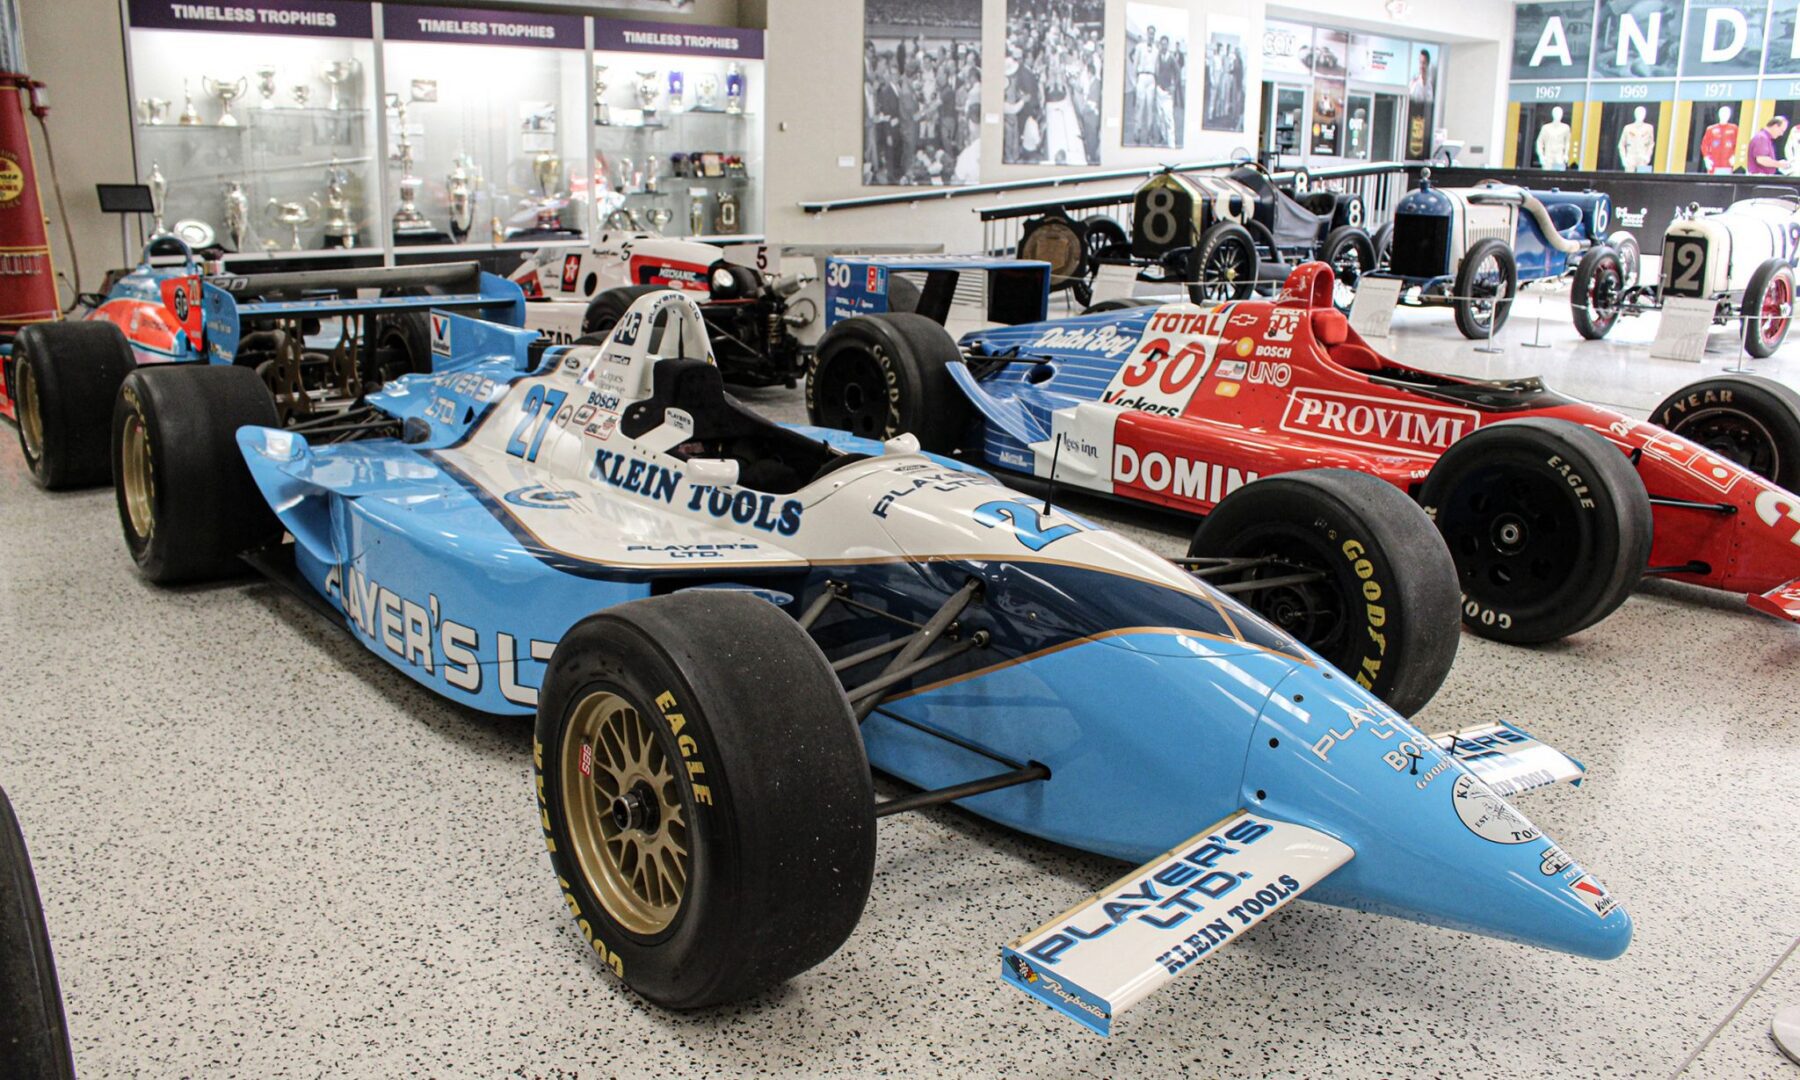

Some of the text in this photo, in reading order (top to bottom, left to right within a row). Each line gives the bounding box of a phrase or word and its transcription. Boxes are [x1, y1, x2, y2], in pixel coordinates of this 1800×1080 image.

[171, 4, 336, 27] TIMELESS TROPHIES
[418, 19, 555, 39] TIMELESS TROPHIES
[623, 31, 739, 50] TIMELESS TROPHIES
[1535, 86, 1561, 98] 1967
[1620, 85, 1647, 98] 1969
[1704, 83, 1732, 97] 1971
[1296, 171, 1308, 193] 8
[1143, 187, 1177, 244] 8
[1348, 199, 1361, 228] 8
[1593, 200, 1608, 232] 16
[757, 246, 768, 270] 5
[1664, 242, 1704, 291] 12
[658, 268, 697, 281] MECHANIC
[827, 262, 851, 288] 30
[1150, 312, 1222, 336] TOTAL
[1089, 325, 1138, 359] Boy
[1255, 345, 1292, 359] BOSCH
[1122, 338, 1206, 395] 30
[1247, 361, 1292, 388] UNO
[587, 391, 619, 412] BOSCH
[1103, 389, 1180, 419] Vickers
[505, 383, 568, 463] 27
[1294, 398, 1466, 449] PROVIMI
[589, 448, 683, 504] KLEIN
[1112, 443, 1260, 505] DOMIN
[1547, 455, 1595, 509] EAGLE
[687, 484, 804, 536] TOOLS
[627, 542, 759, 552] PLAYER'S
[580, 744, 602, 777] BBS
[655, 690, 714, 806] EAGLE
[1025, 818, 1274, 965] PLAYER'S
[1138, 870, 1254, 929] LTD.
[1155, 874, 1301, 975] KLEIN TOOLS
